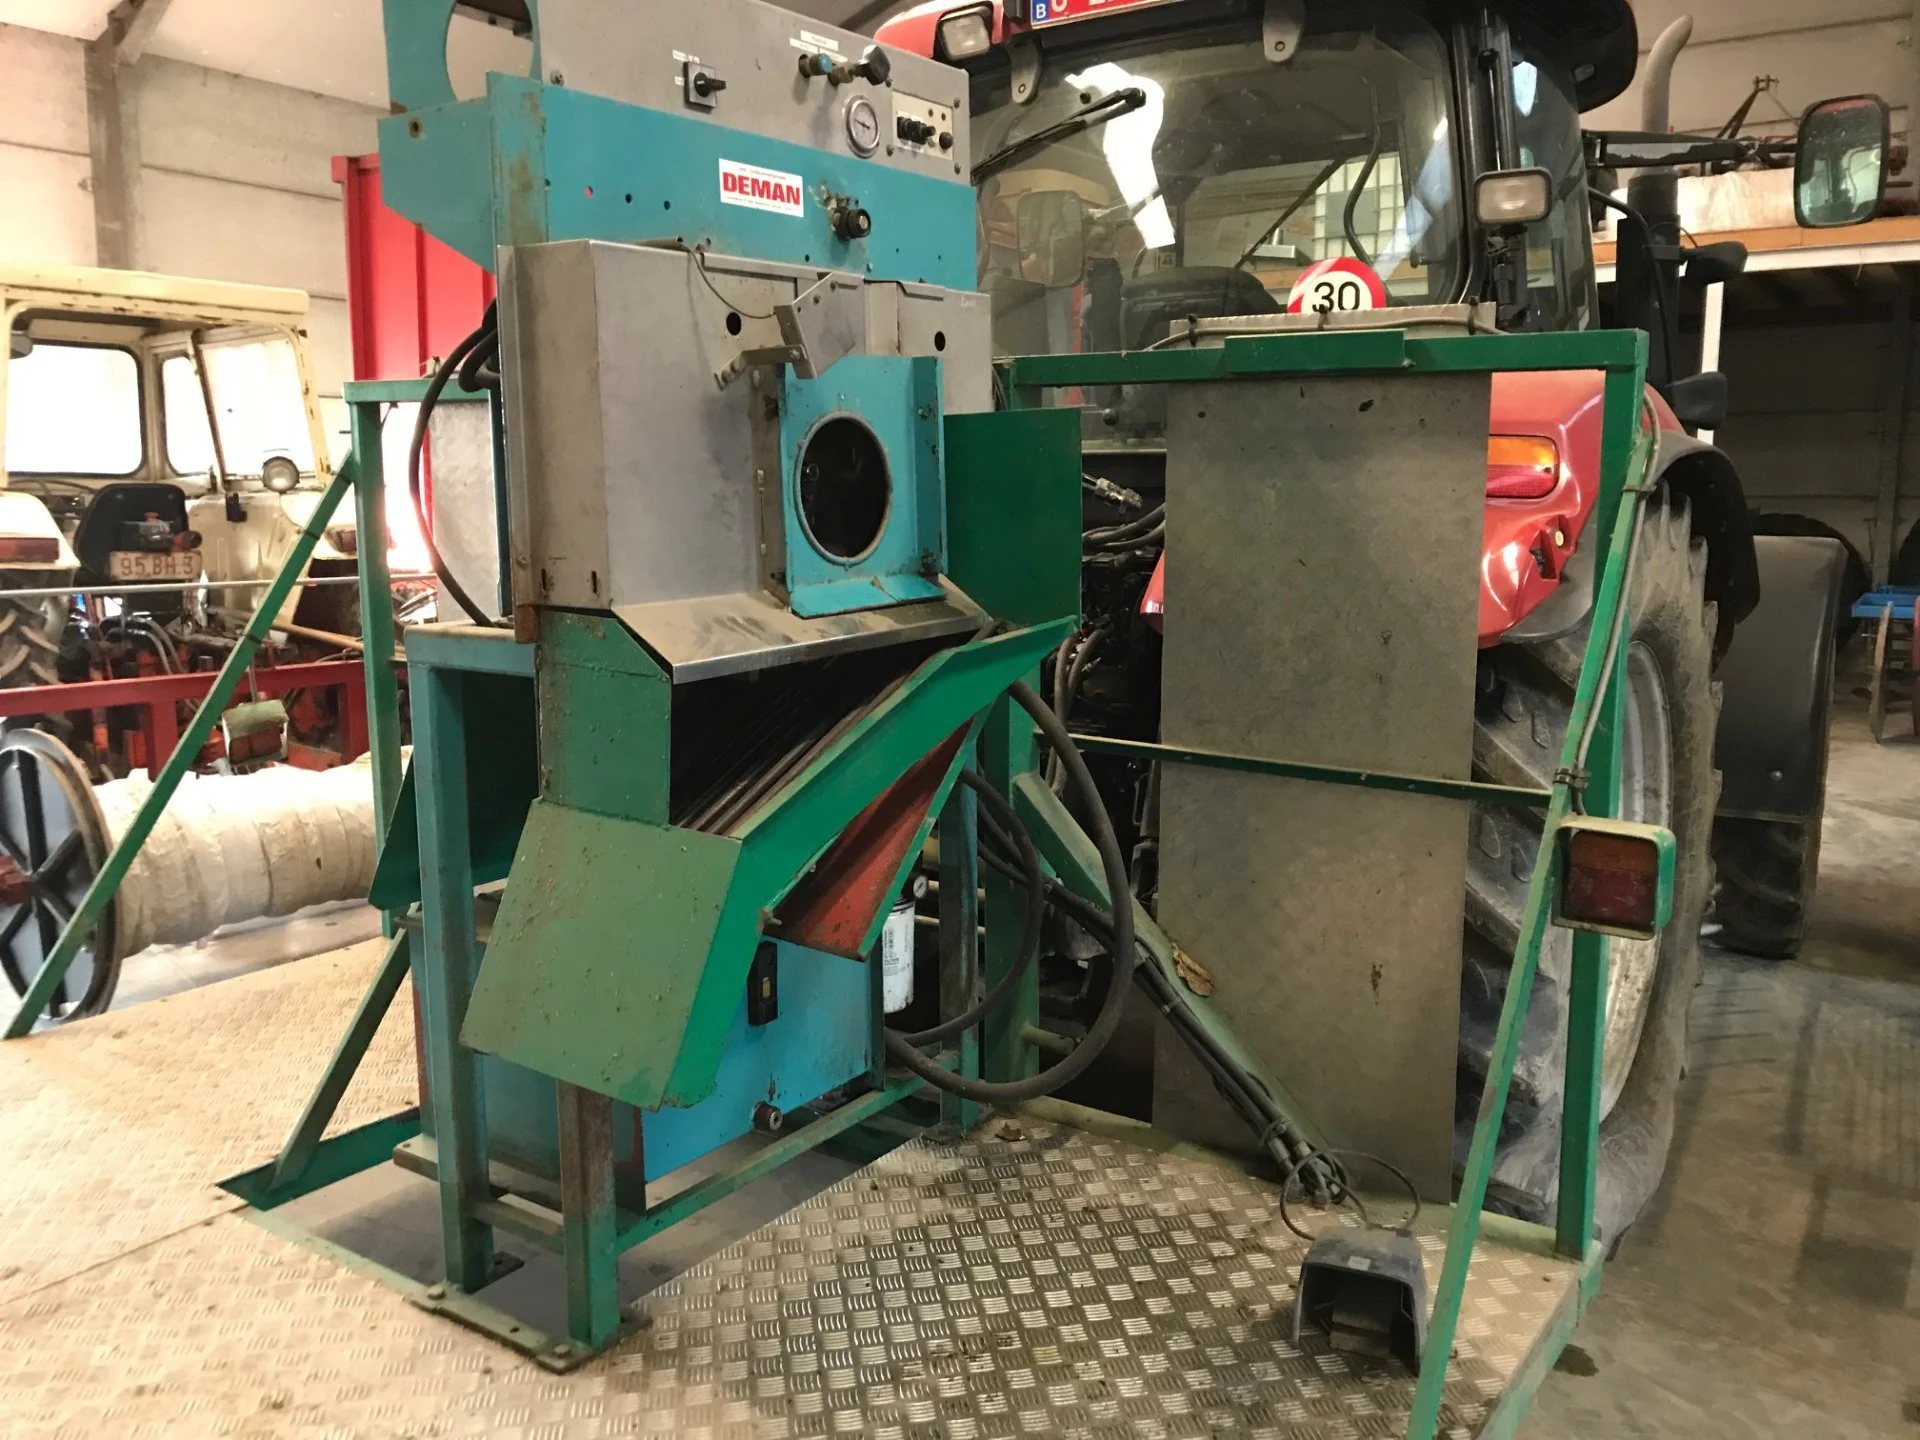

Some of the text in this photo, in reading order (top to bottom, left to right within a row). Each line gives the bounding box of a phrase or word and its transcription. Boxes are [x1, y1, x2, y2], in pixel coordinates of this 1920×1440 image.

[1036, 3, 1047, 19] B
[722, 171, 801, 206] DEMAN
[1312, 281, 1360, 313] 30
